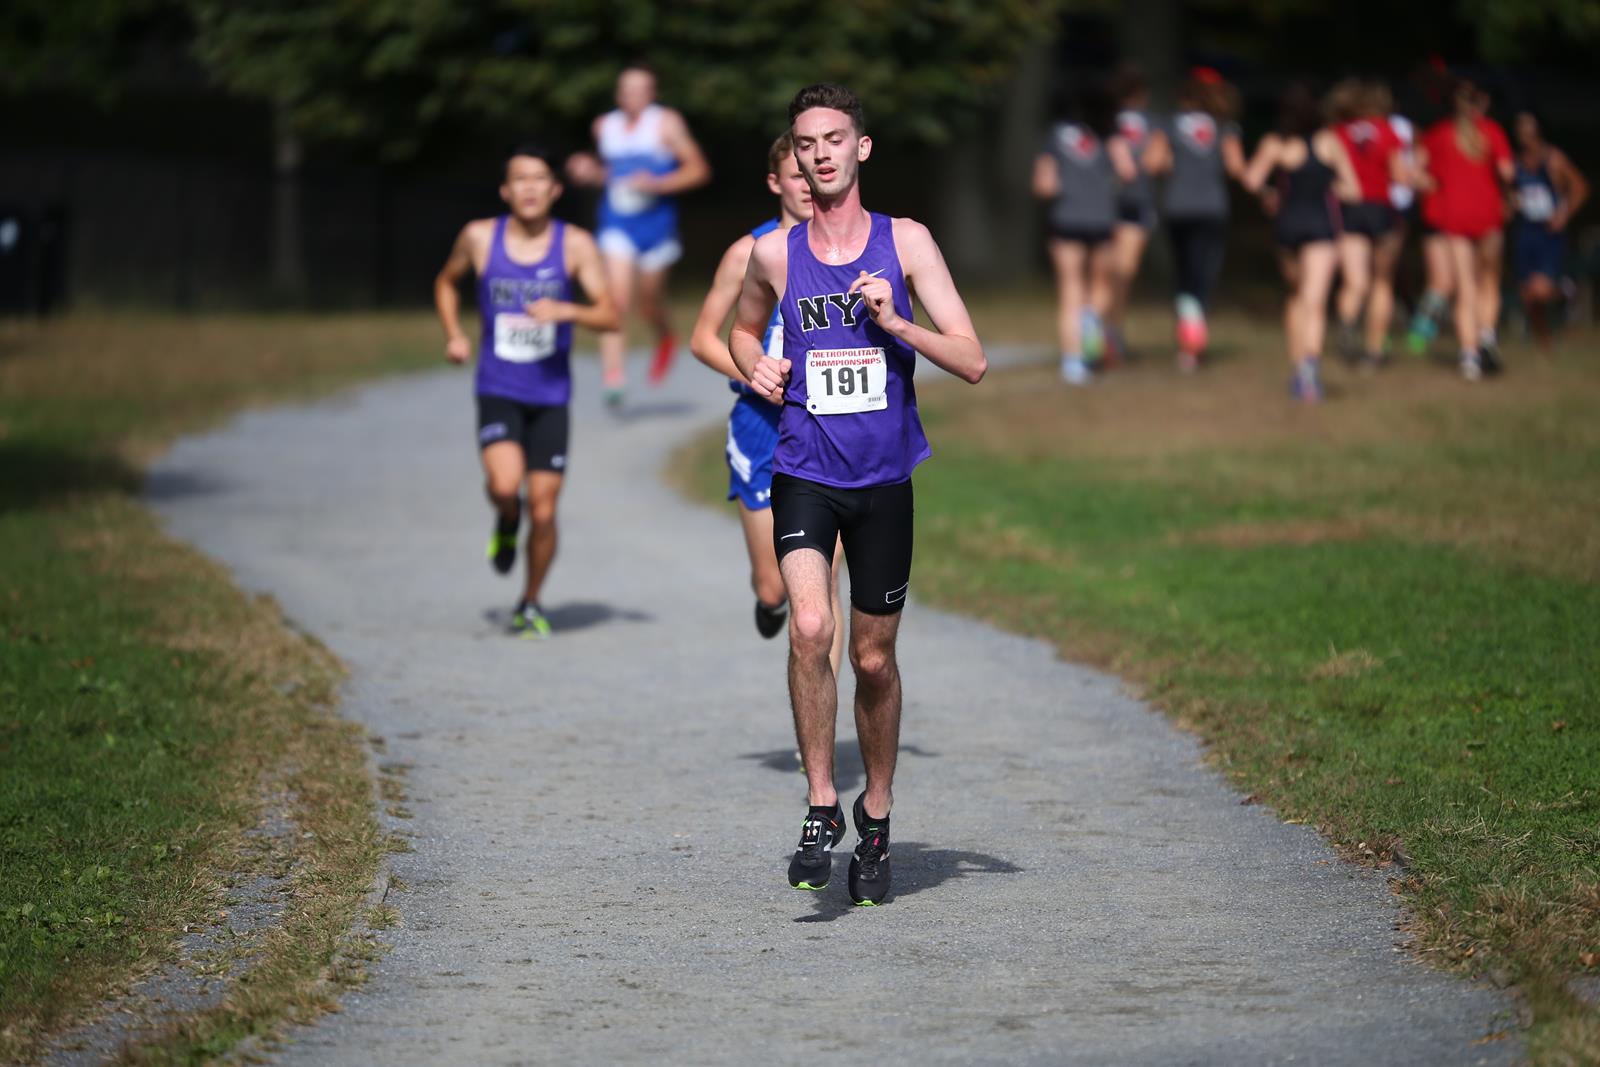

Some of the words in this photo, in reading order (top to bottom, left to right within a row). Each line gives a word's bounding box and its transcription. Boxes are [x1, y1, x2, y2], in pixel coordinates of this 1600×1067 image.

[798, 291, 864, 332] NY
[810, 357, 882, 367] CHAMPIONSHIPS
[812, 349, 880, 358] METROPOLITAN
[821, 366, 869, 396] 191
